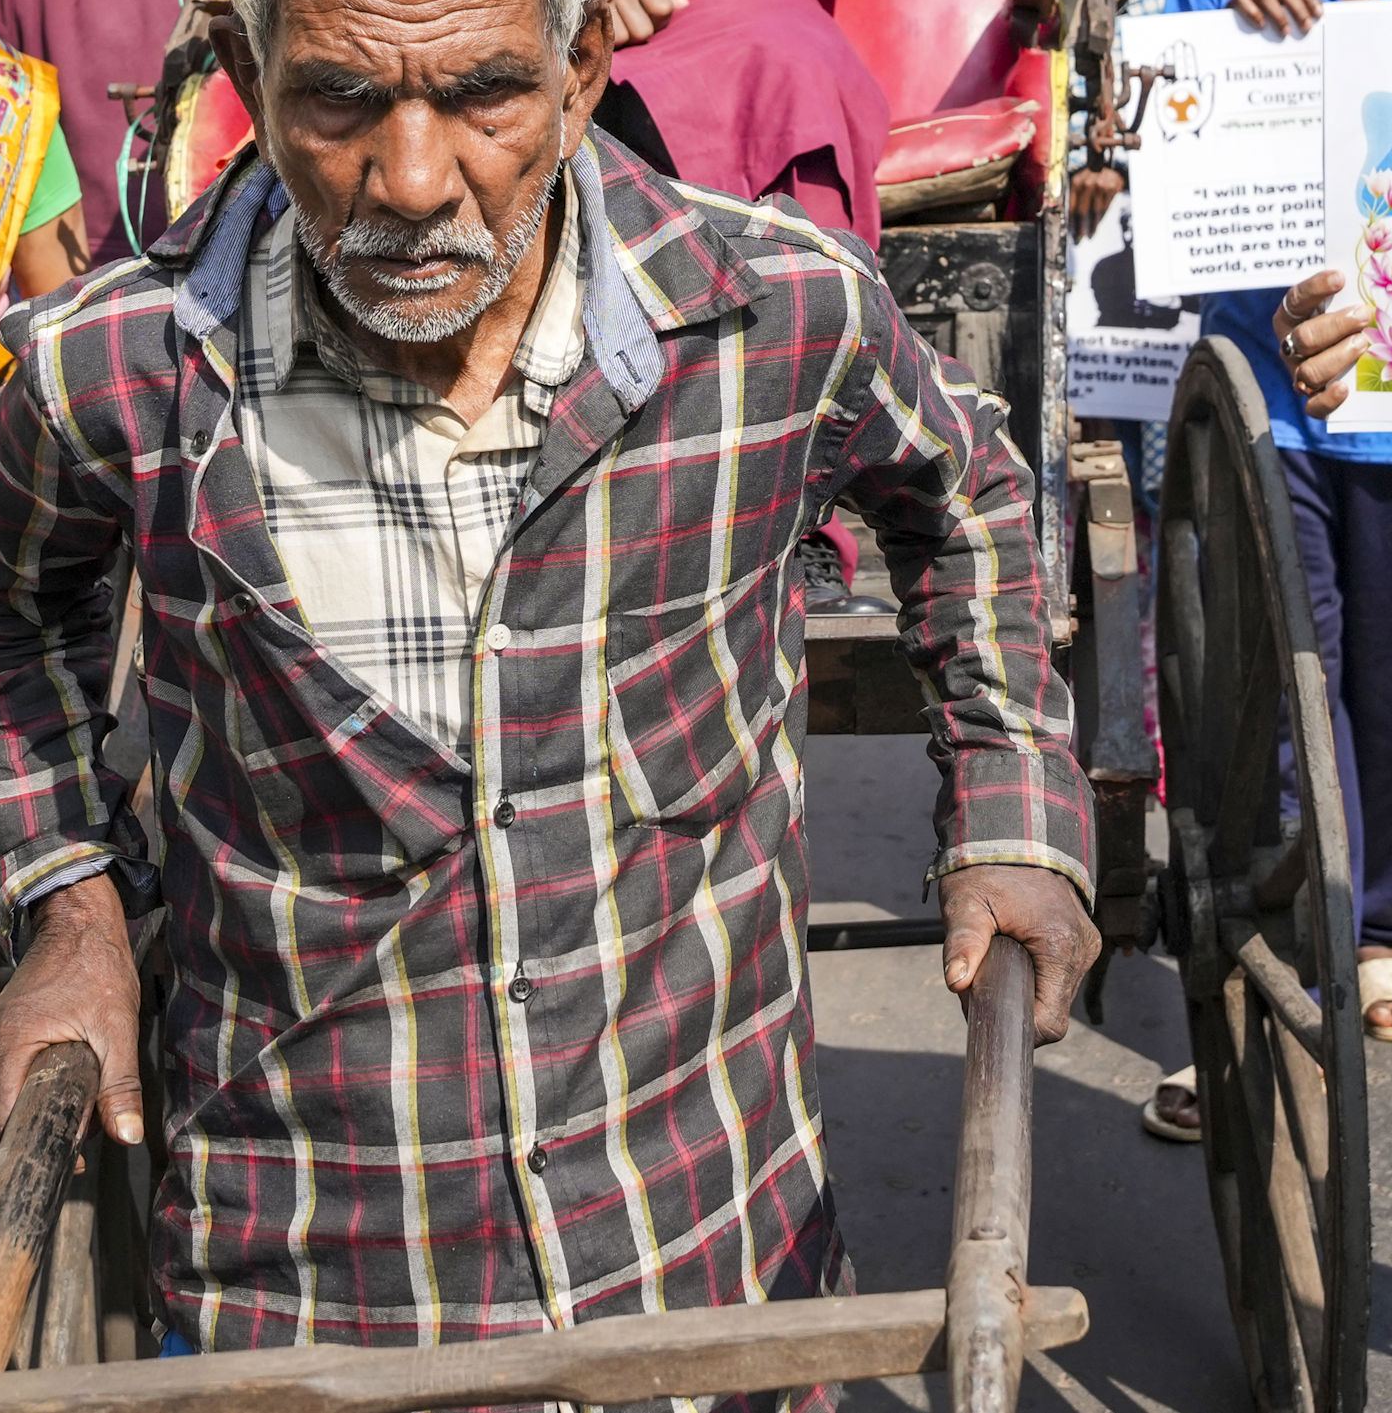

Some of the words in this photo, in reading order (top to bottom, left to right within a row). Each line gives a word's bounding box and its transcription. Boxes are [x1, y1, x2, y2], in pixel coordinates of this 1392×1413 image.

[1214, 185, 1246, 198] will
[1253, 182, 1298, 195] have
[1172, 204, 1250, 221] cowards
[1256, 203, 1275, 214] or
[1282, 198, 1323, 214] polit
[1173, 227, 1202, 240] not
[1208, 221, 1275, 237] believe
[1281, 219, 1297, 230] in
[1189, 242, 1234, 257] truth
[1241, 241, 1270, 252] are
[1278, 238, 1307, 250] the
[1190, 260, 1248, 275] world,
[1253, 254, 1324, 270] everyth
[1111, 335, 1180, 352] because
[1074, 370, 1126, 382] better
[1132, 372, 1169, 385] than
